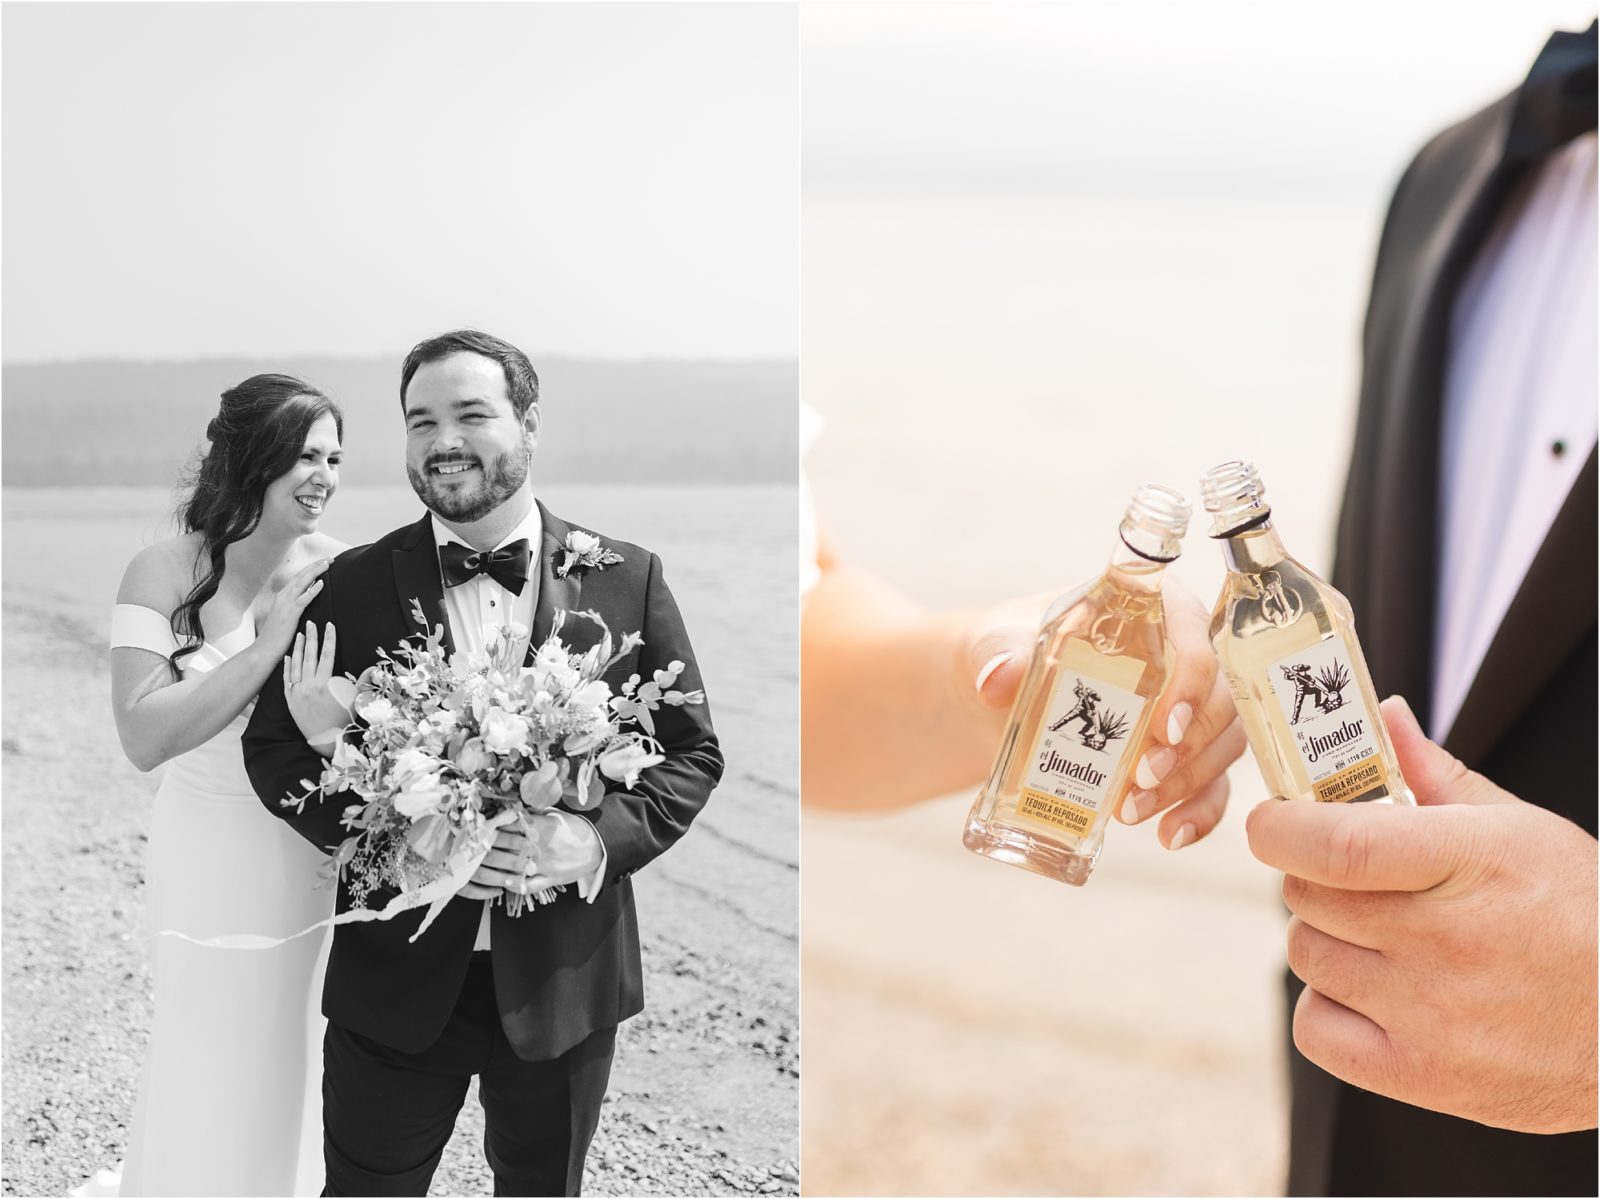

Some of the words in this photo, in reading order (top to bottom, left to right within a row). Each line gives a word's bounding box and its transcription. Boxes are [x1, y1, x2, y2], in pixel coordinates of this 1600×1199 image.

[1302, 742, 1310, 753] el
[1309, 720, 1363, 762] Jimador
[1040, 750, 1107, 786] Jimador
[1320, 781, 1346, 799] TEQUILA
[1346, 765, 1378, 787] REPOSADO
[1025, 797, 1051, 813] TEQUILA
[1053, 806, 1088, 826] REPOSADO
